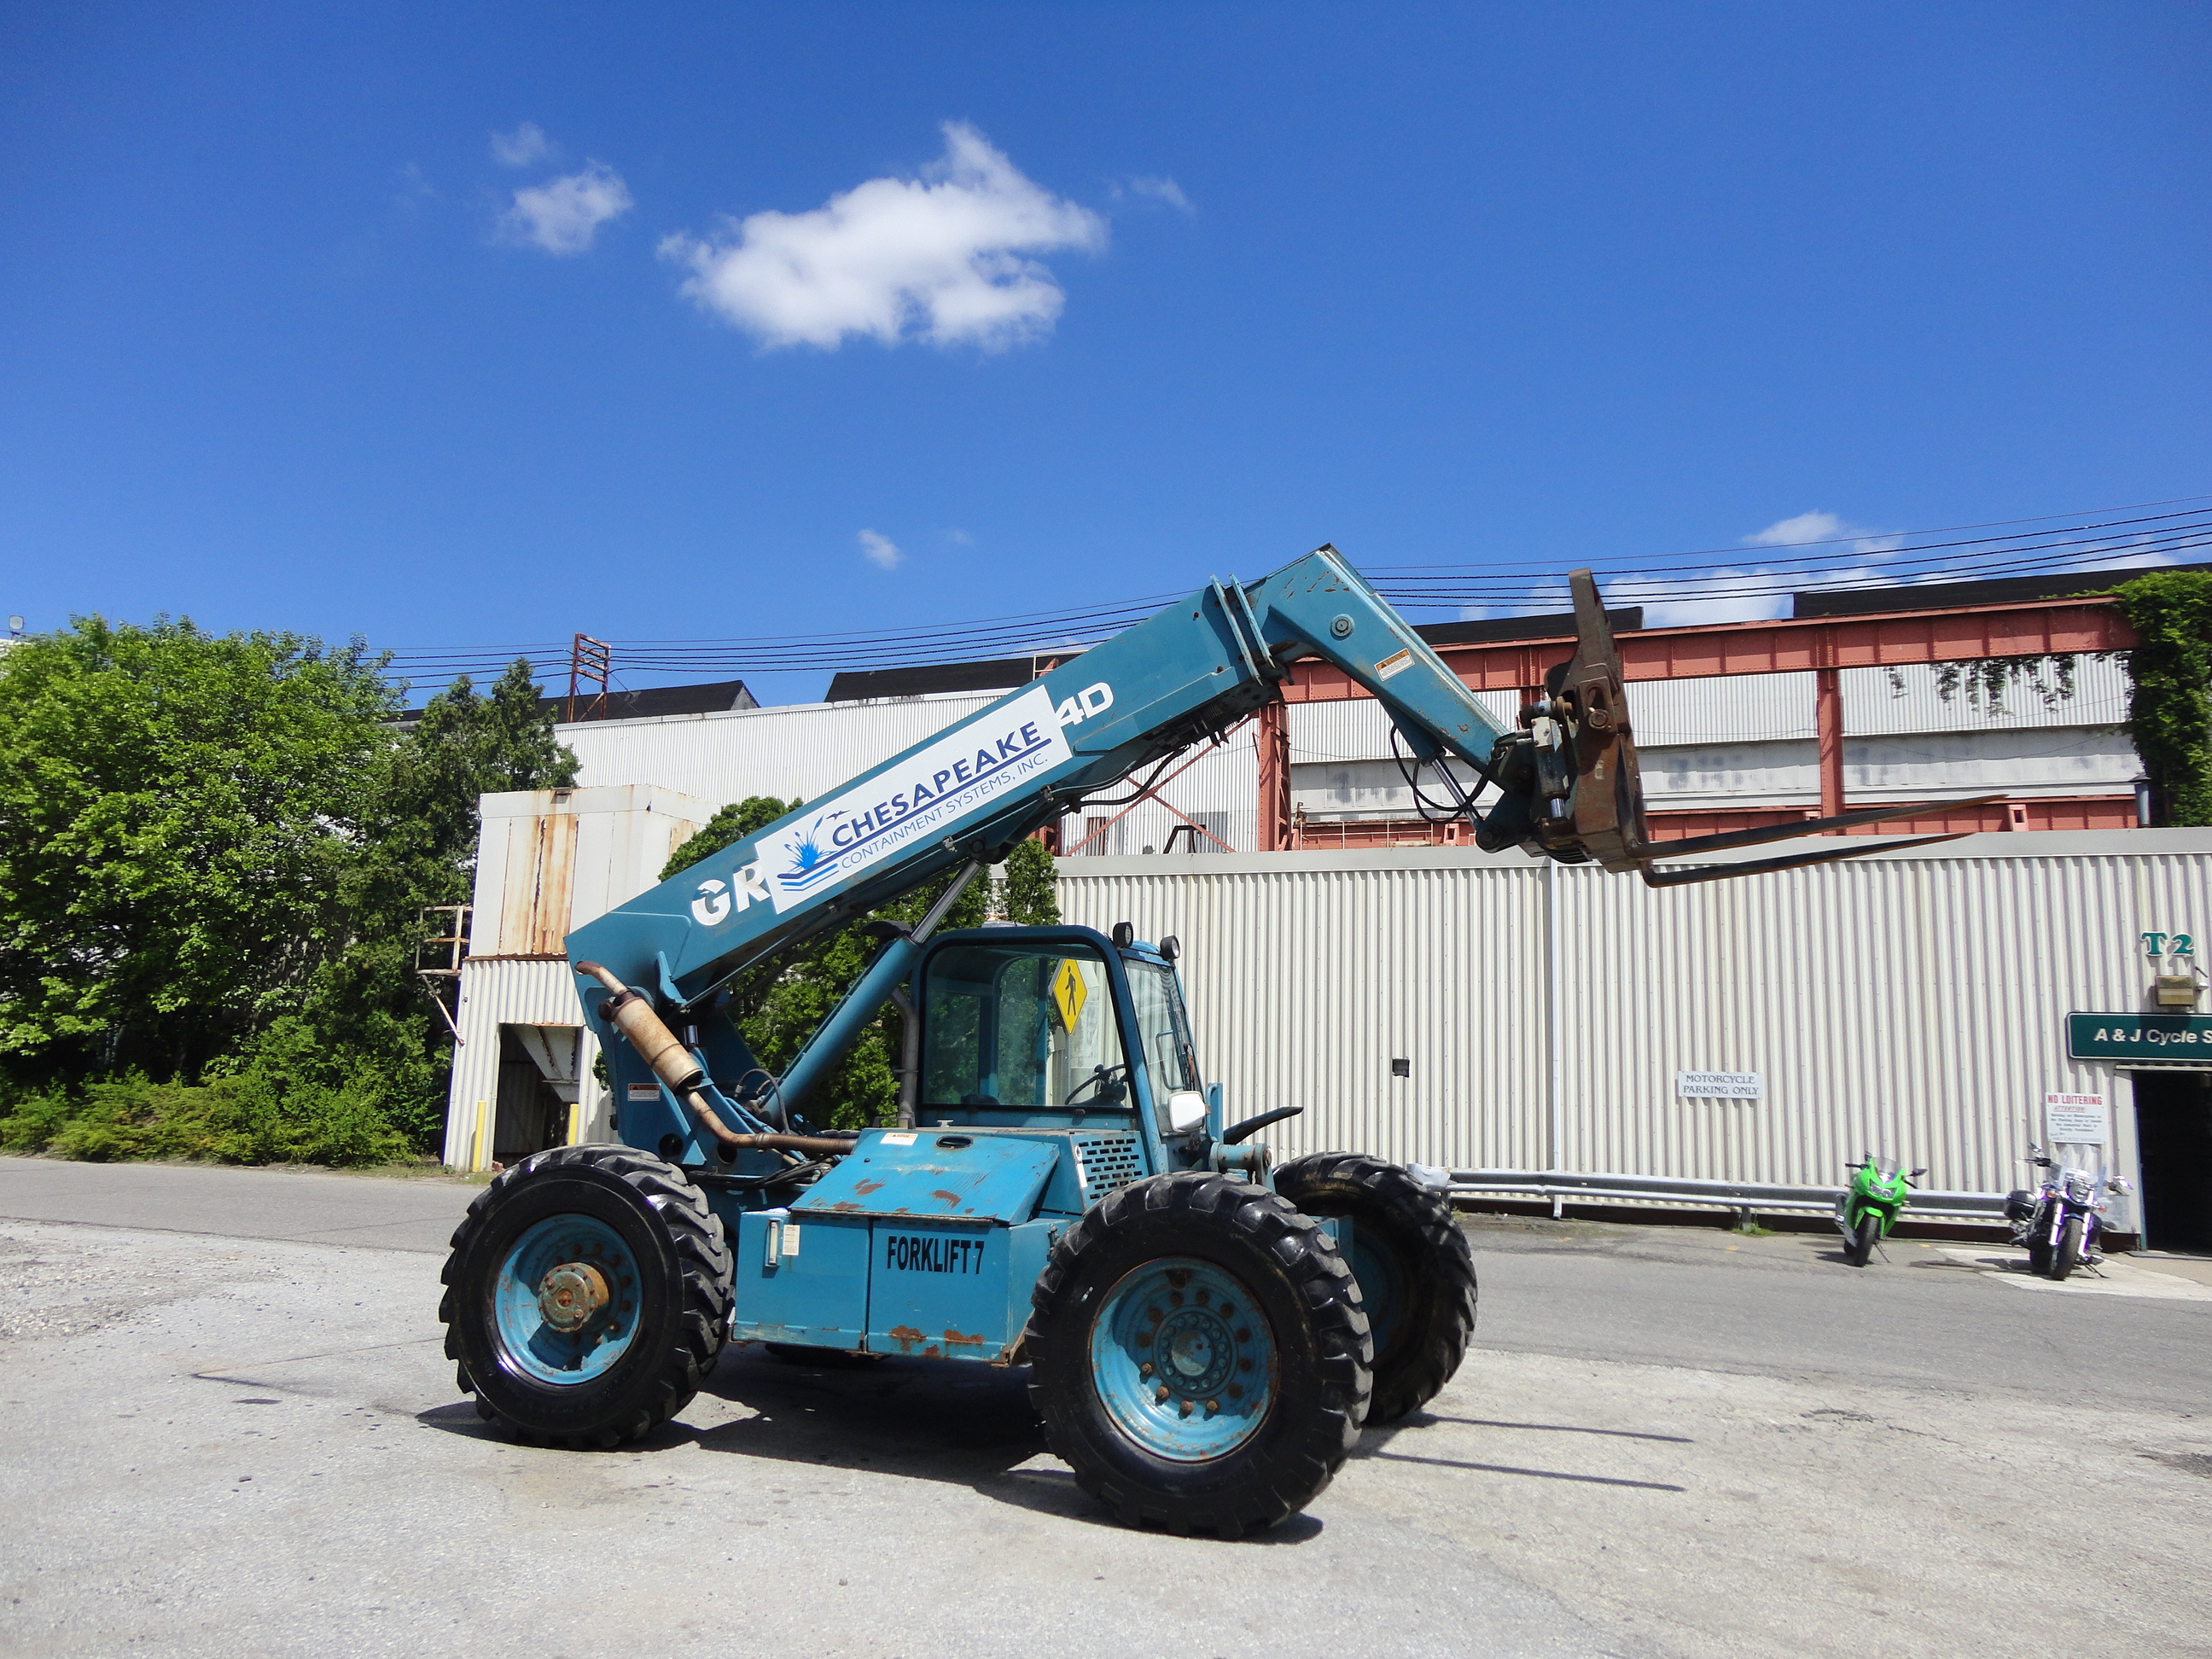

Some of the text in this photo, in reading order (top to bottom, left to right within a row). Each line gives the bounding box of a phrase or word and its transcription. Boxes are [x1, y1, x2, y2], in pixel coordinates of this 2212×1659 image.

[832, 721, 1041, 847] CHESAPEAKE
[841, 753, 1048, 869] CONTAINMENT SYSTEMS, INC.
[2140, 931, 2195, 957] T2
[2093, 1027, 2108, 1042] A
[2112, 1028, 2126, 1042] &
[2129, 1028, 2141, 1042] J
[2146, 1029, 2197, 1046] Cycle
[1683, 1086, 1759, 1095] PARKING ONLY
[1685, 1075, 1755, 1085] MOTORCYCLE
[2047, 1095, 2103, 1105] NO LOITERING
[887, 1236, 985, 1275] FORKLIFT 7
